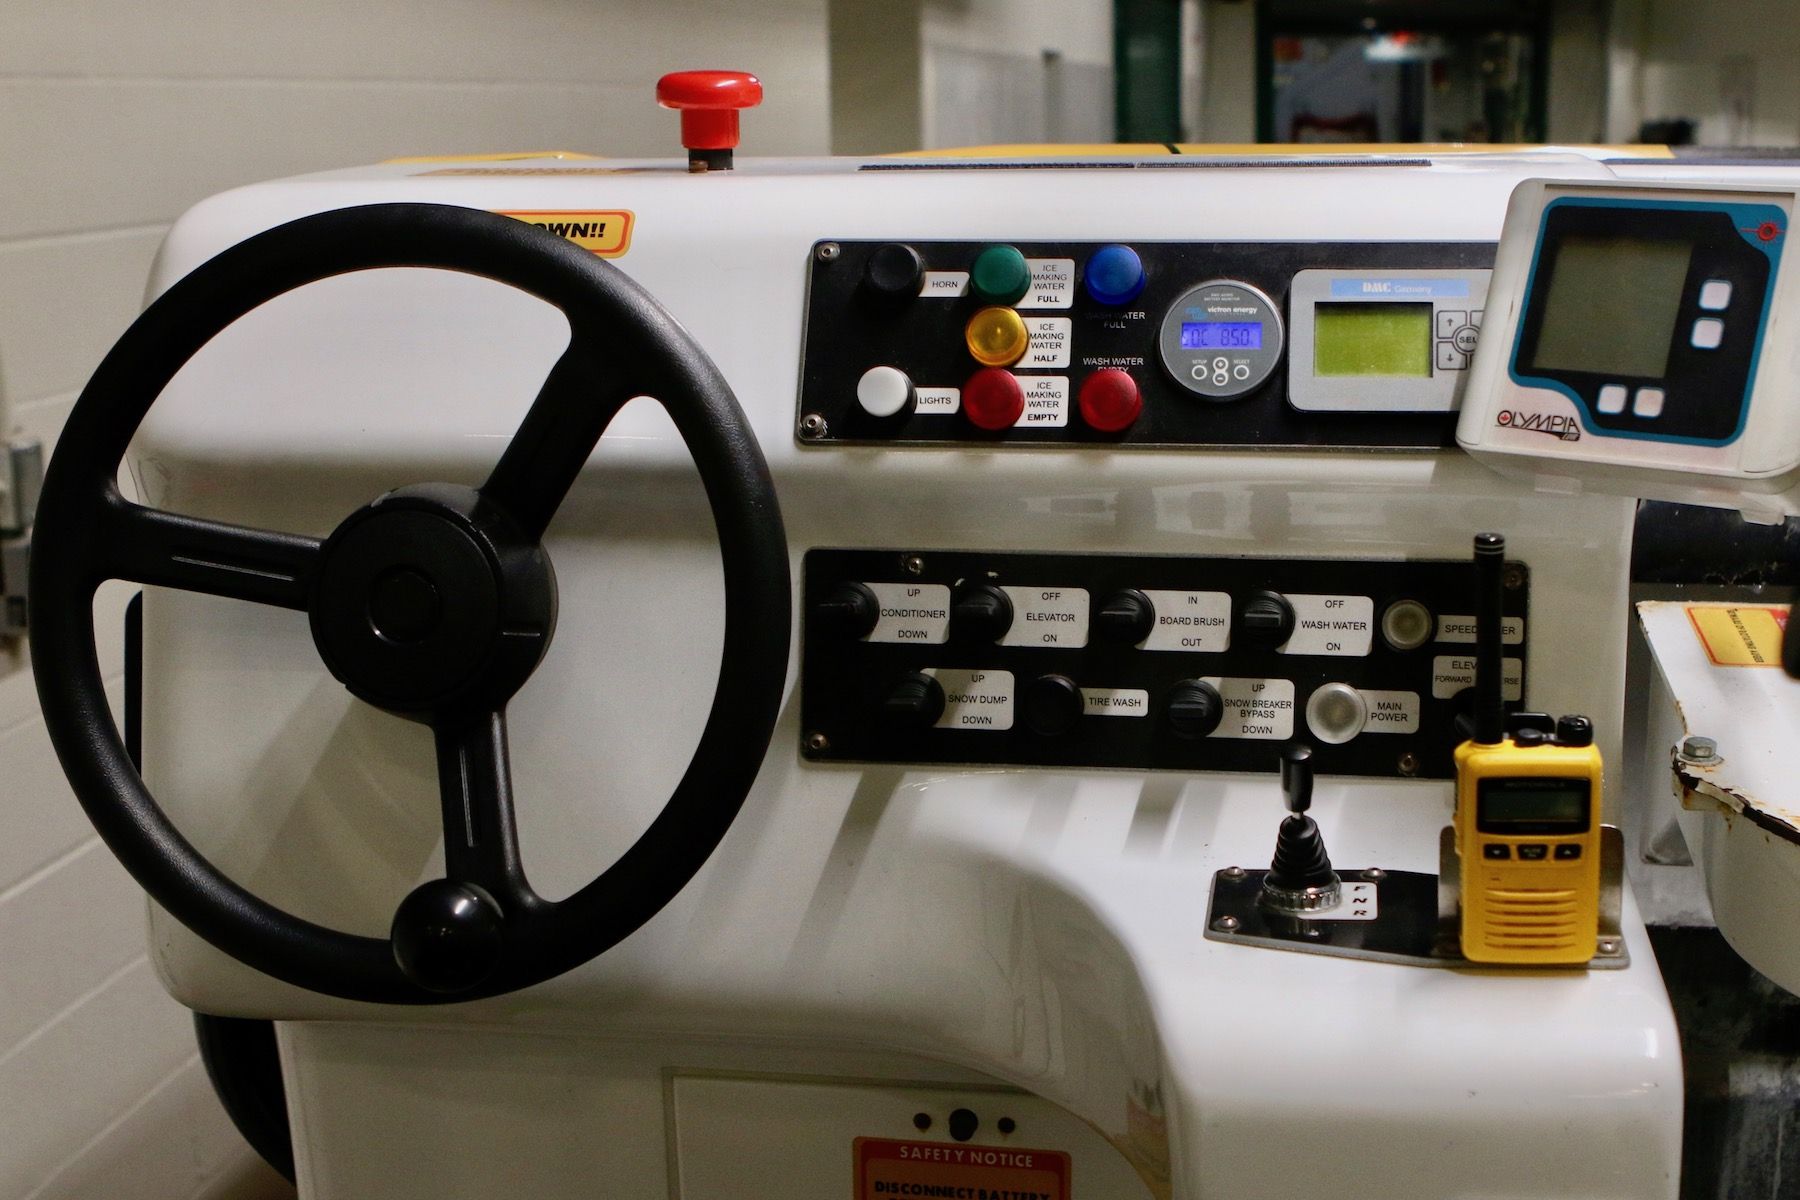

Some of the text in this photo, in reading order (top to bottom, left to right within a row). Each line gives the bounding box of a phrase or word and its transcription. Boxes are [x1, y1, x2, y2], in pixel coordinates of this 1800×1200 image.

[1033, 273, 1067, 281] MAKING
[932, 280, 958, 289] HORN
[1363, 282, 1432, 293] DMC Germany
[1037, 295, 1060, 303] FULL
[1083, 357, 1144, 365] WASH WATER
[1026, 391, 1062, 399] MAKING
[920, 397, 951, 405] LIGHTS
[1028, 400, 1059, 408] WATER
[1027, 414, 1058, 422] EMPTY
[1497, 410, 1580, 433] OLYMPIA
[907, 589, 920, 597] UP
[1041, 592, 1061, 600] OFF
[1188, 596, 1198, 604] IN
[1325, 600, 1344, 608] OFF
[881, 609, 946, 618] CONDITIONER
[1026, 613, 1075, 622] ELEVATOR
[1160, 617, 1225, 626] BOARD BRUSH
[1302, 620, 1367, 631] WASH WATER
[898, 630, 927, 638] DOWN
[1043, 634, 1057, 642] ON
[1326, 643, 1341, 651] ON
[1452, 661, 1476, 670] ELEV
[972, 674, 985, 682] UP
[1435, 675, 1472, 684] FORWARD
[1252, 684, 1265, 692] UP
[948, 695, 1008, 704] SNOW DUMP
[1089, 697, 1141, 707] TIRE WASH
[1225, 699, 1292, 708] SNOW BREAKER
[1377, 702, 1401, 711] MAIN
[1241, 710, 1275, 718] BYPASS
[1371, 713, 1408, 722] POWER
[962, 716, 992, 724] DOWN
[1242, 726, 1272, 734] DOWN
[900, 1146, 1033, 1168] SAFETY NOTICE
[875, 1180, 975, 1199] DISCONNECT
